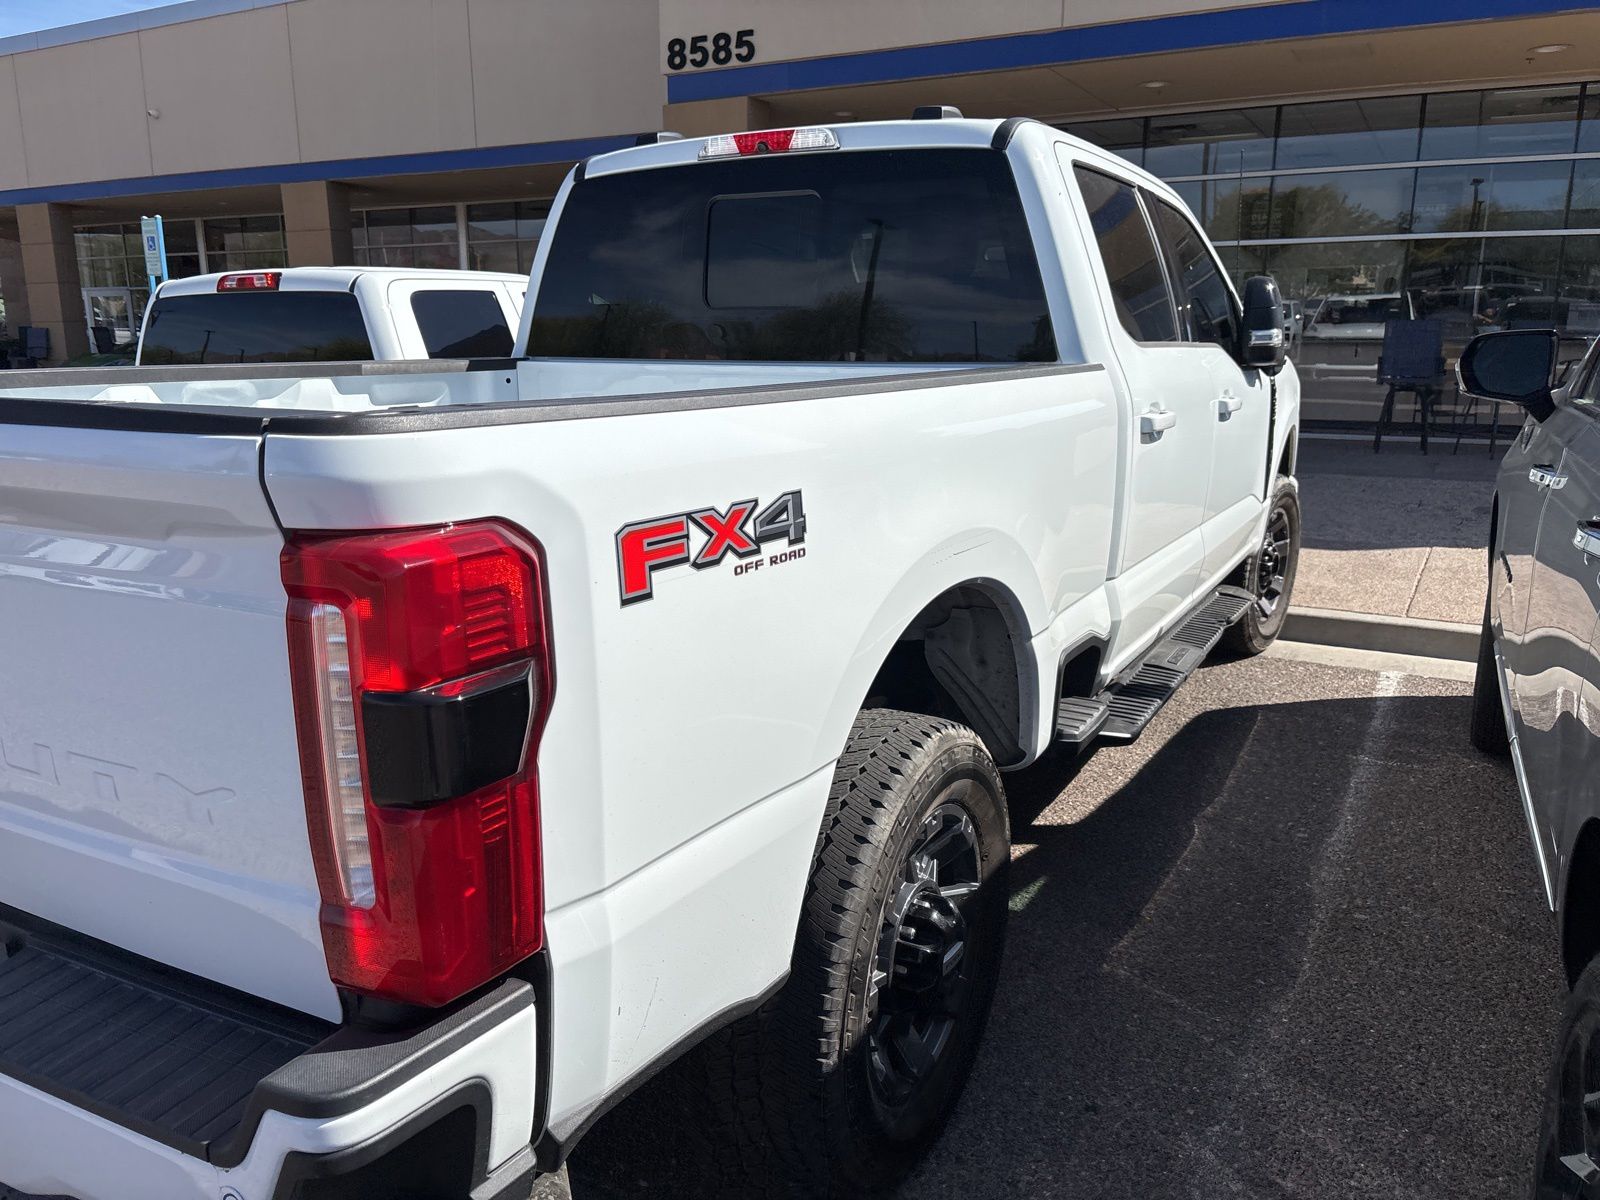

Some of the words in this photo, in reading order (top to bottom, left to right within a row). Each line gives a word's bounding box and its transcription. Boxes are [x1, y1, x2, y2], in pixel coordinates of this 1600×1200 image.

[667, 29, 755, 70] 8585
[614, 488, 807, 609] FX4
[734, 559, 764, 576] OFF
[769, 547, 806, 566] ROAD
